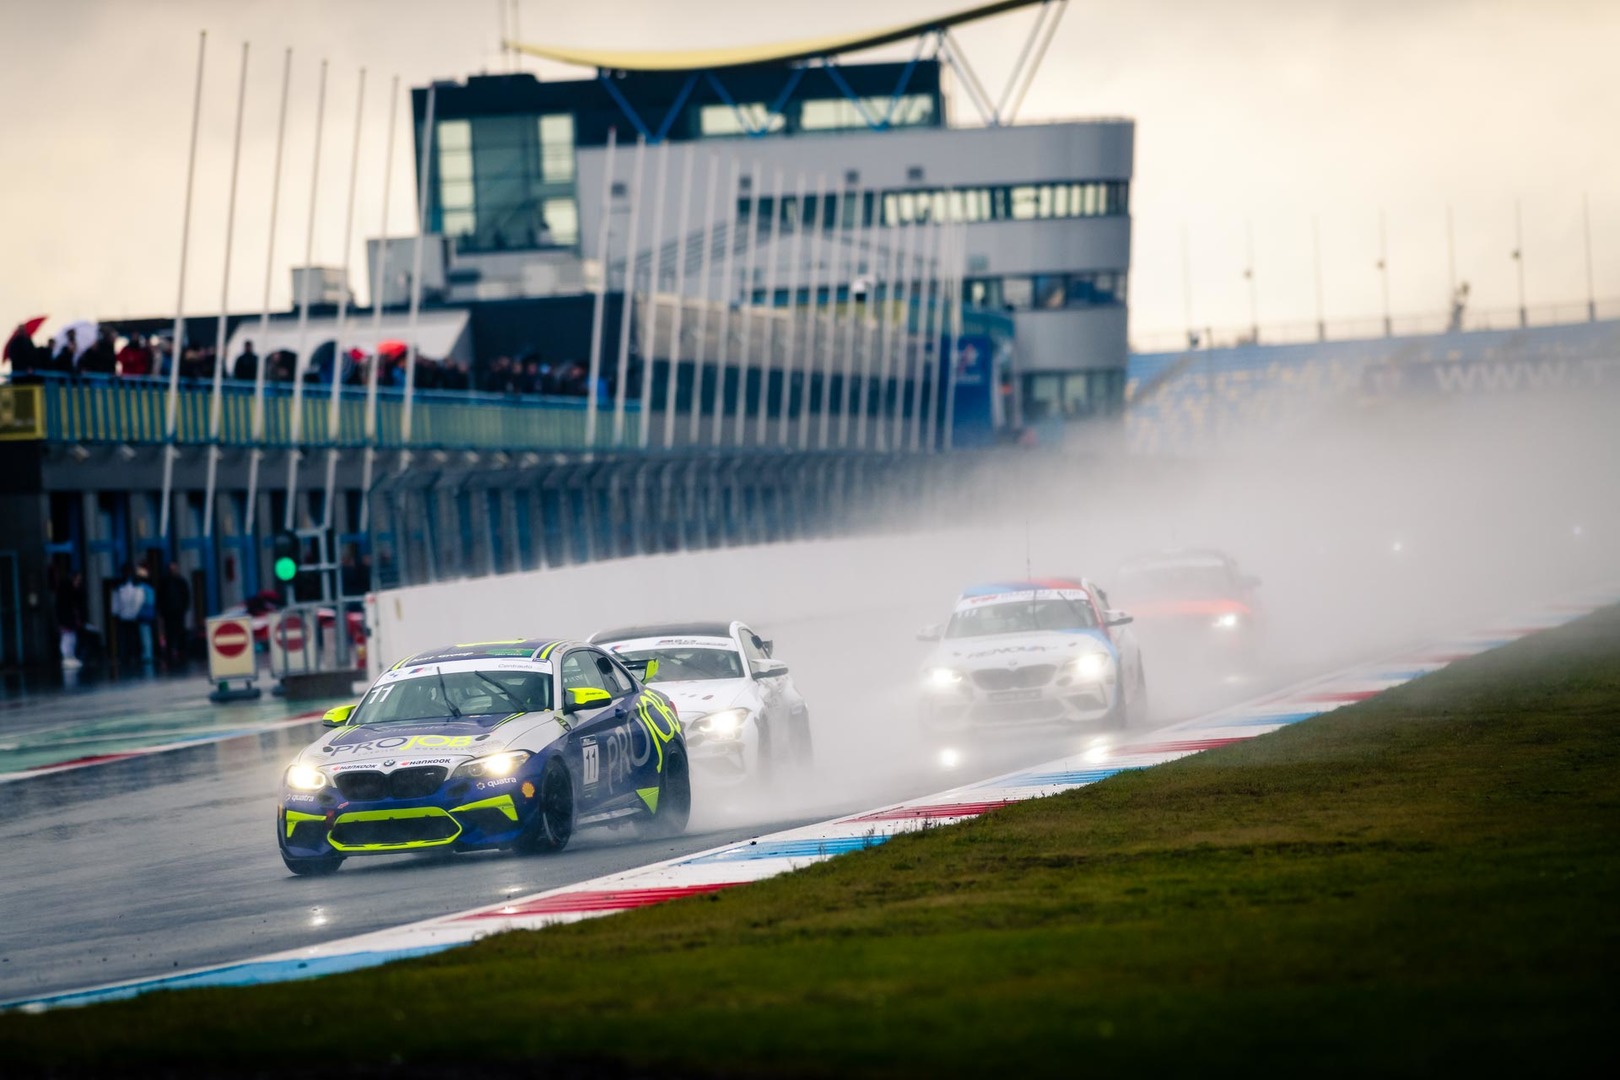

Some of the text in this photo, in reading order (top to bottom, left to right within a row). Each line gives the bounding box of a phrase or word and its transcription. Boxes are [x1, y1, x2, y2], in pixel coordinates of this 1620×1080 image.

[368, 684, 396, 705] 11
[330, 735, 473, 757] PROJOB
[585, 748, 597, 780] 11
[487, 777, 517, 788] quatra
[291, 794, 315, 802] quatra
